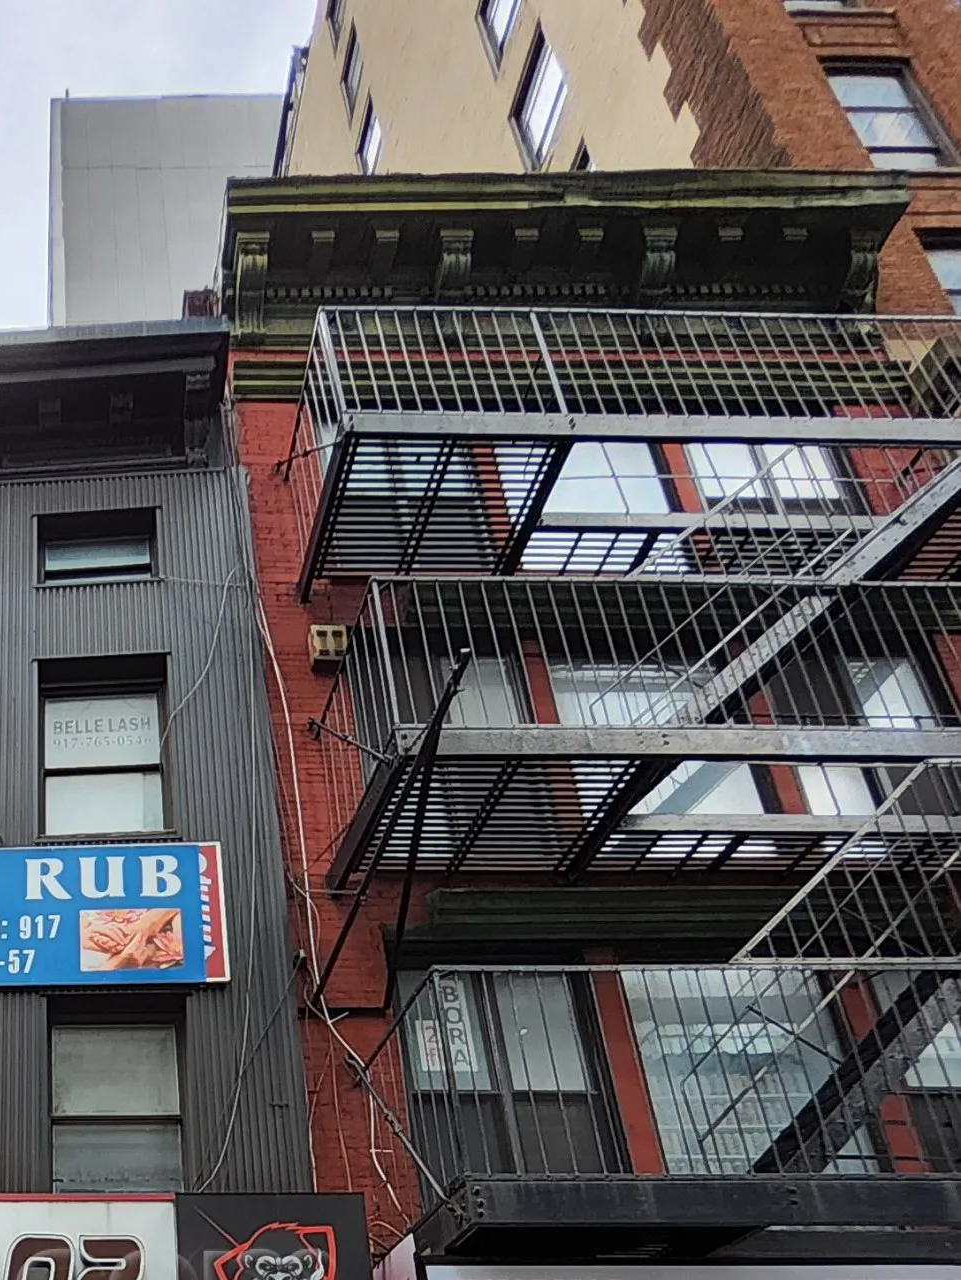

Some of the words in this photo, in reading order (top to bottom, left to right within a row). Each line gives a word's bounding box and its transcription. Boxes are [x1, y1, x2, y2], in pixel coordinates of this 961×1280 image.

[53, 718, 104, 735] BELLE
[108, 716, 151, 732] LASH
[24, 854, 182, 900] RUB
[19, 914, 61, 940] 917
